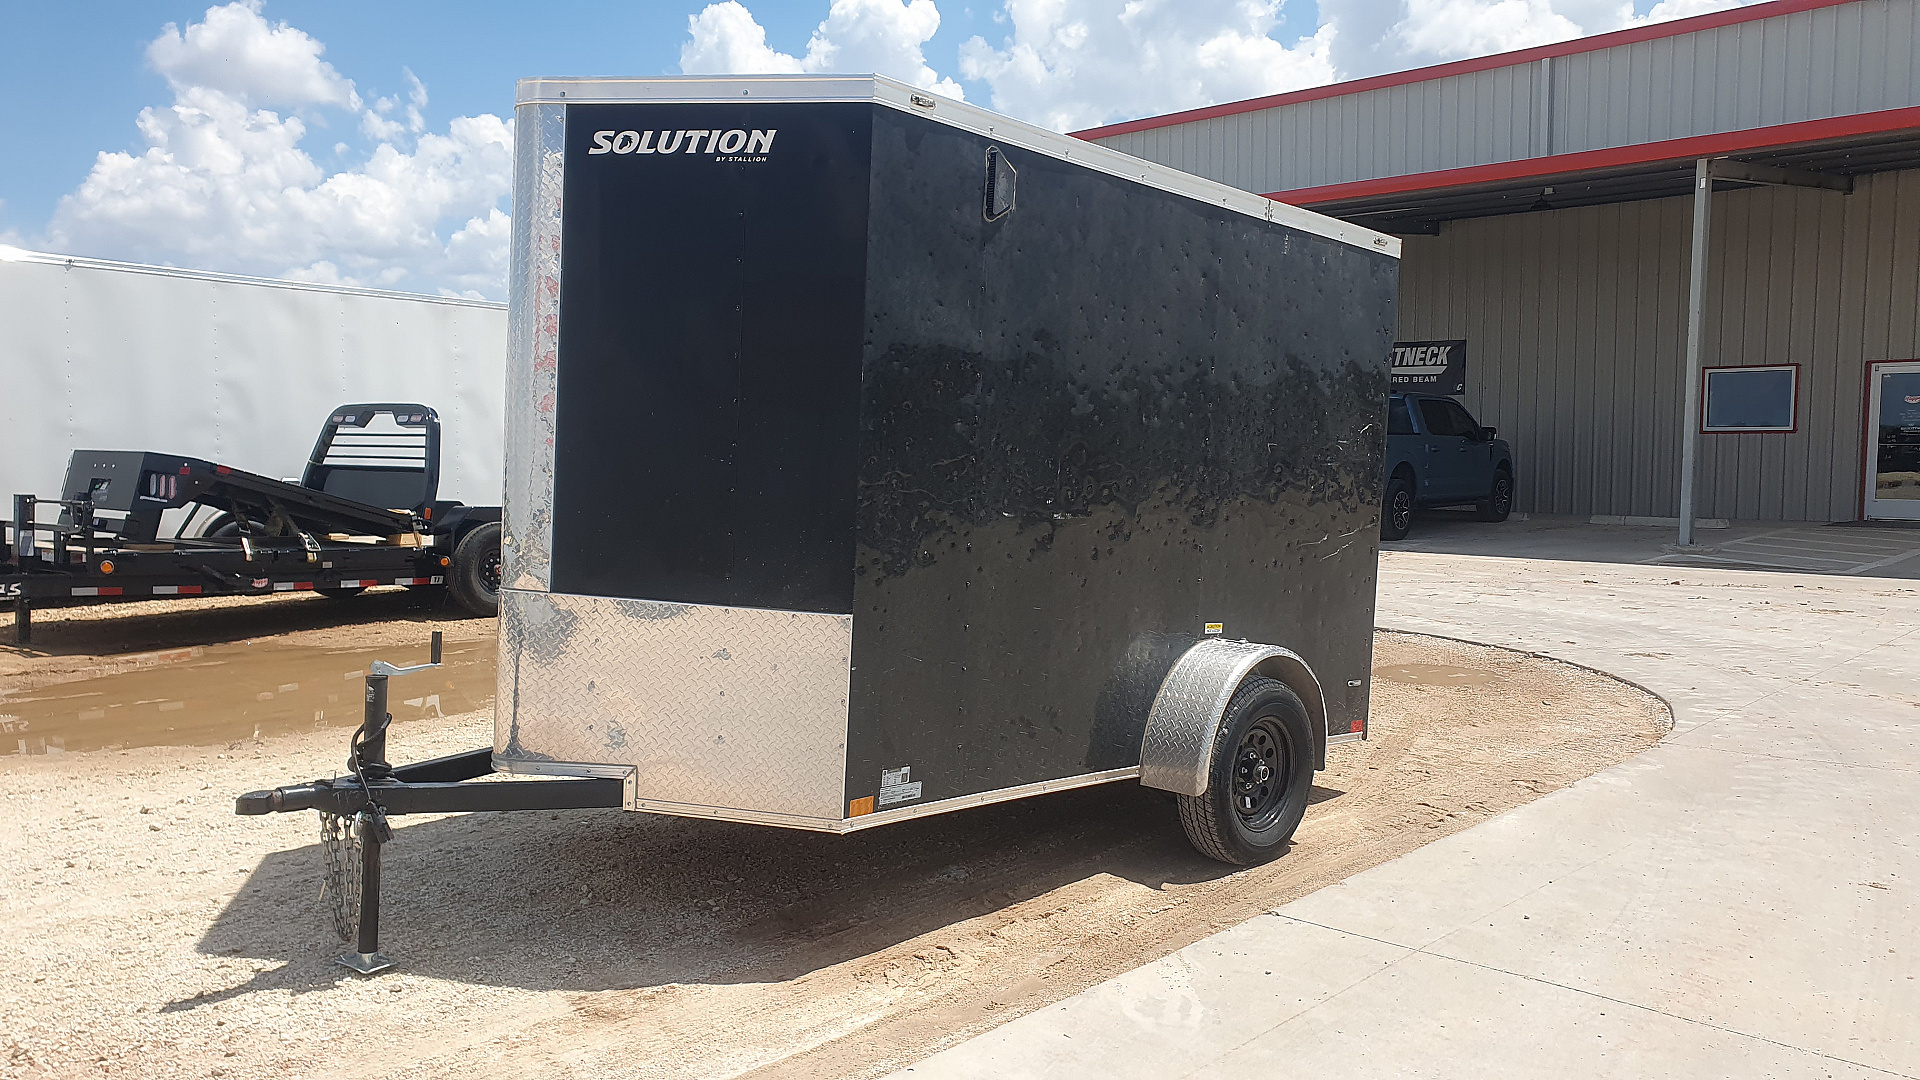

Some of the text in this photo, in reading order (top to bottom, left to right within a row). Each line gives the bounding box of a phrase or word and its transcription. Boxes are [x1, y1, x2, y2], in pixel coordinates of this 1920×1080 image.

[588, 129, 777, 155] SOLUTION
[1393, 346, 1451, 366] TNECK
[1412, 375, 1437, 383] BEAM
